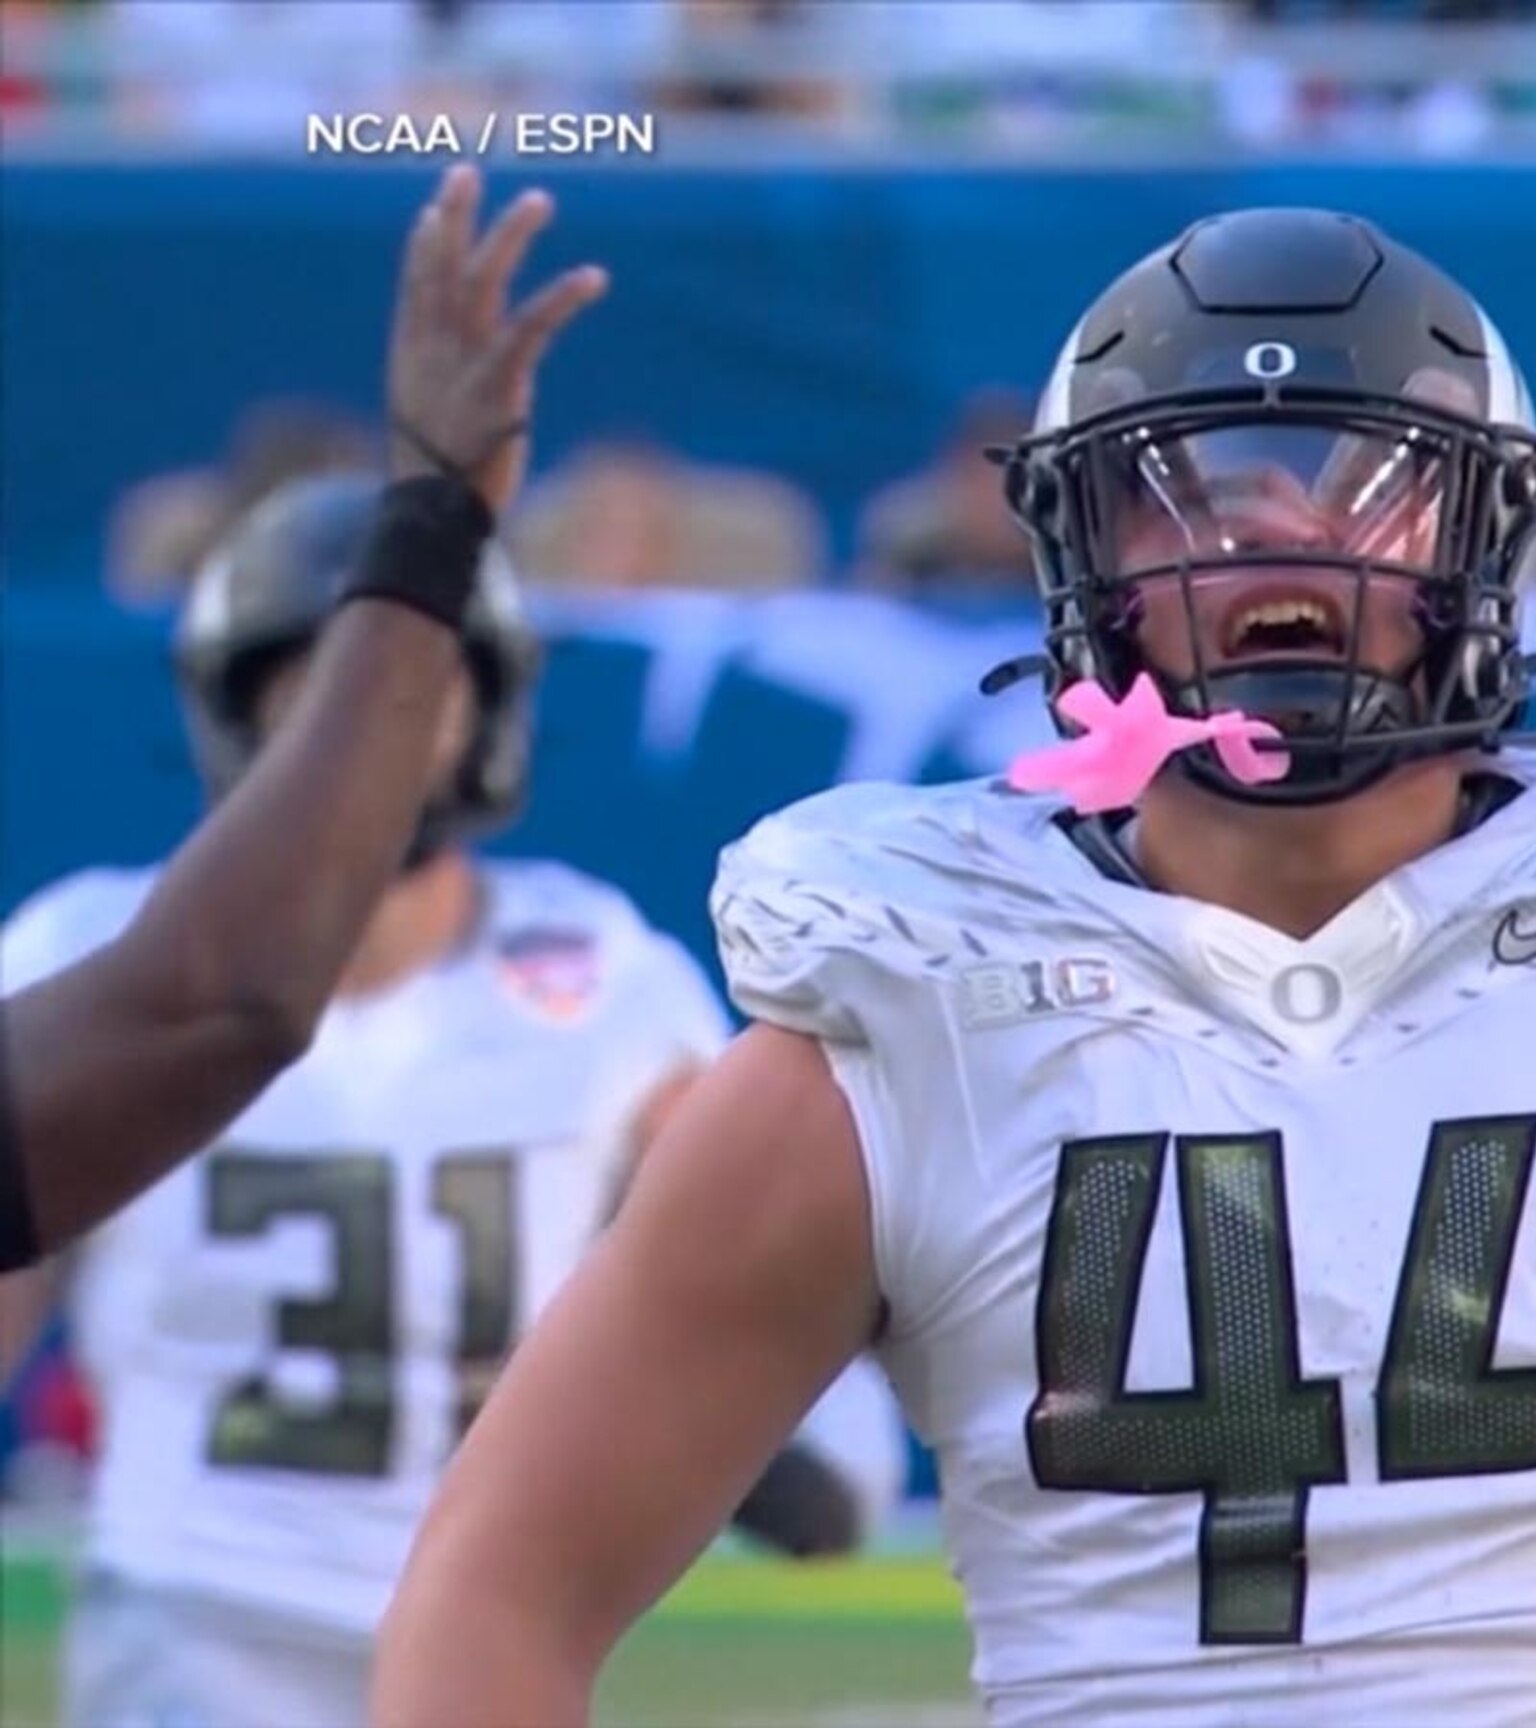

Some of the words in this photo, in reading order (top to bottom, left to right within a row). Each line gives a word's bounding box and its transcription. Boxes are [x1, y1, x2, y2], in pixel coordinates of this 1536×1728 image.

[1244, 341, 1297, 379] O
[1269, 962, 1343, 1026] O
[205, 1148, 522, 1481] 31
